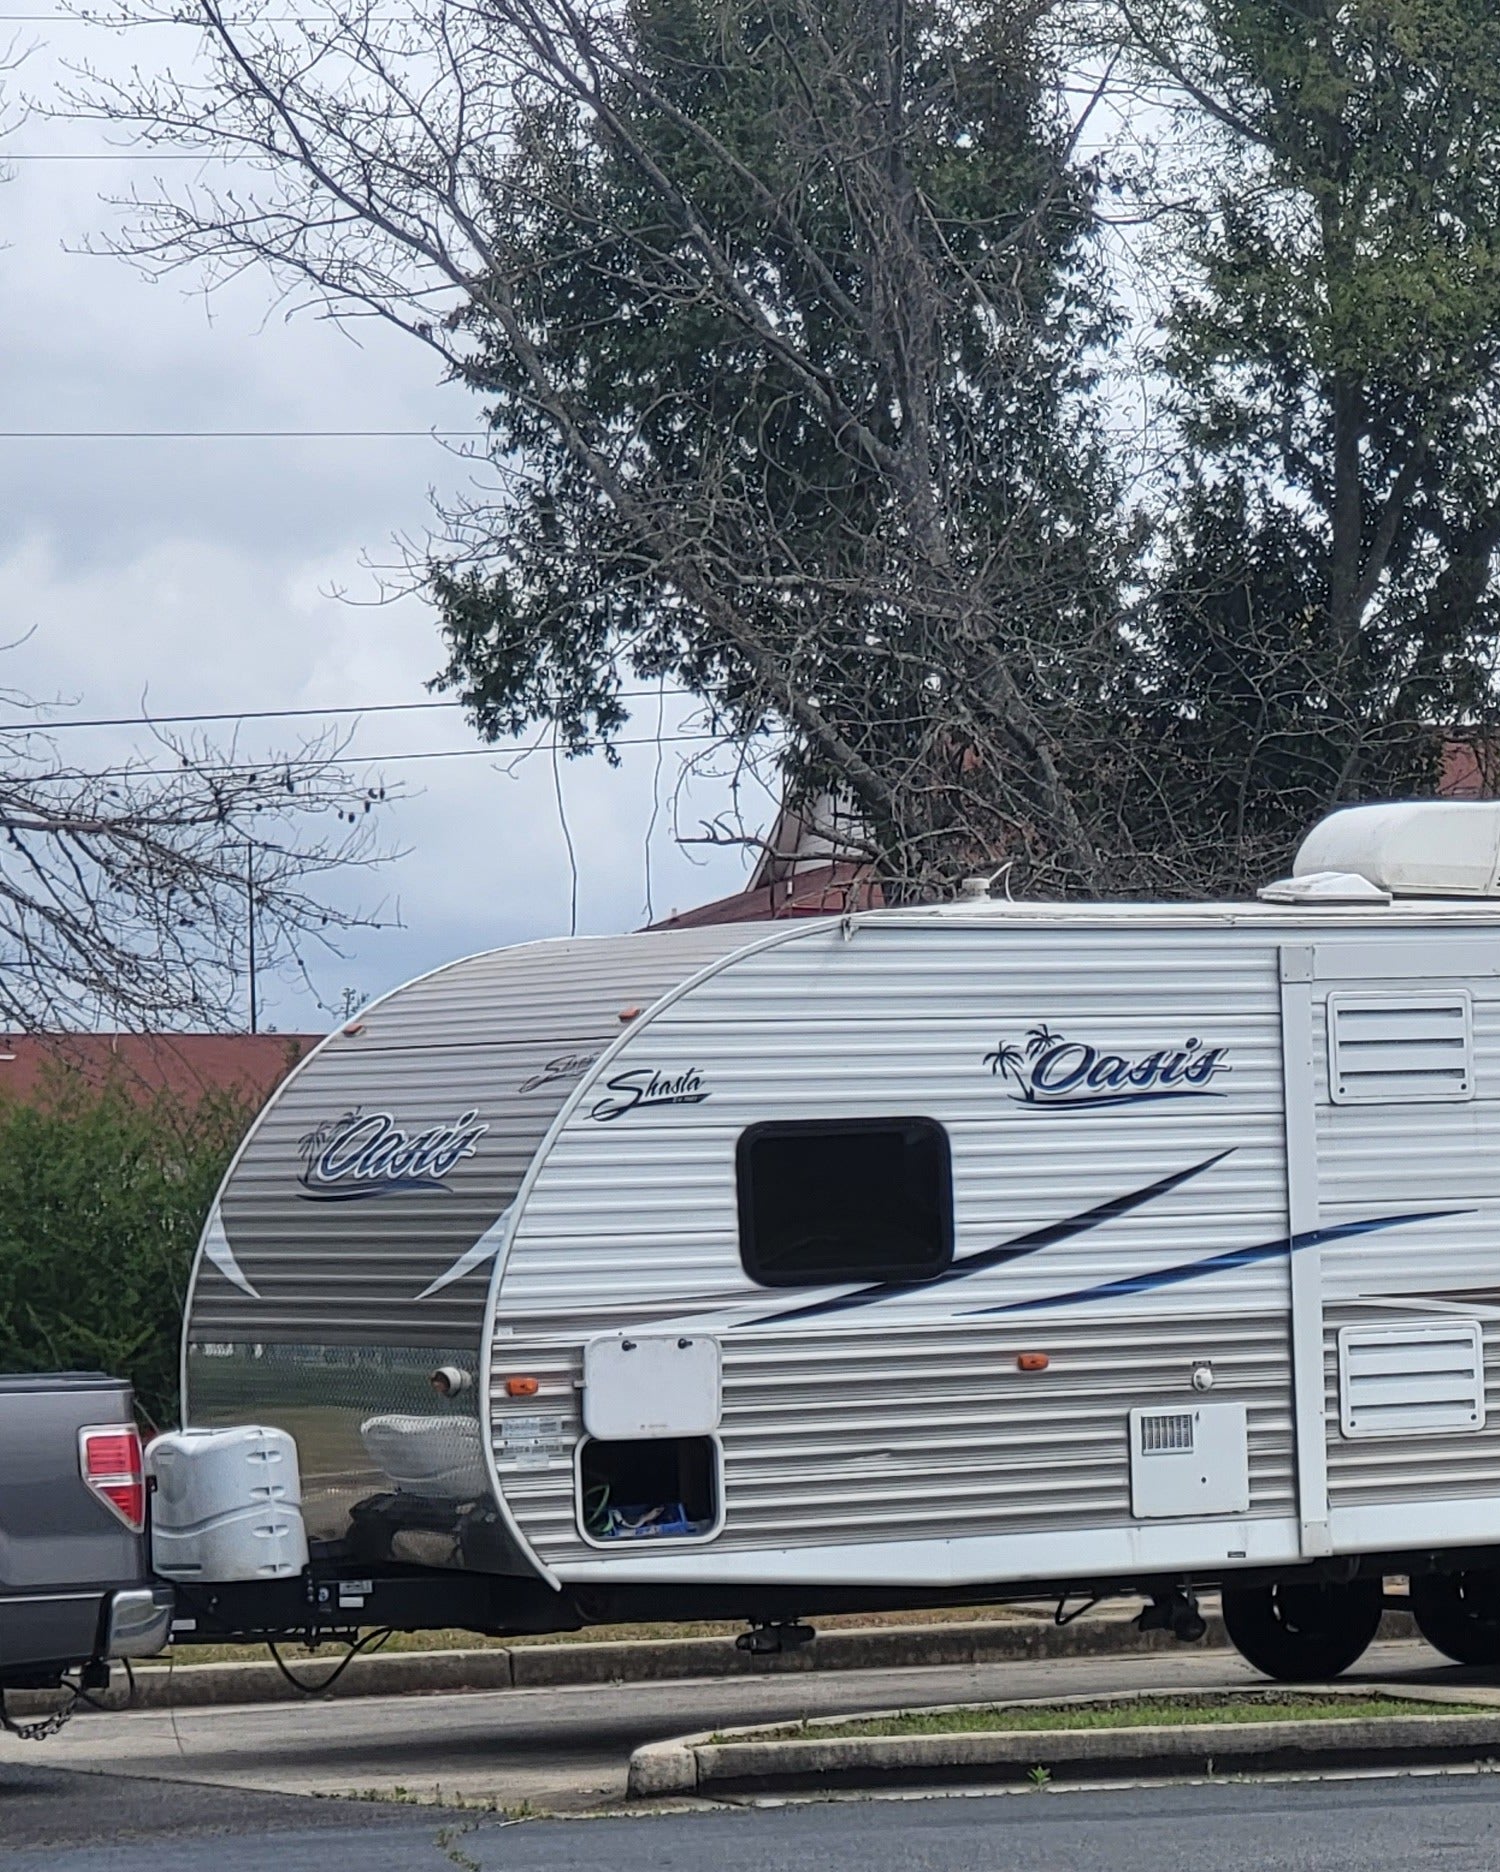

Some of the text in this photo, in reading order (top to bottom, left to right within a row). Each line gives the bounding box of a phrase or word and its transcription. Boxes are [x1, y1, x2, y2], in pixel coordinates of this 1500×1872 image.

[585, 1067, 707, 1122] Shasta
[1030, 1037, 1232, 1095] Oasis
[317, 1108, 489, 1183] Oasis
